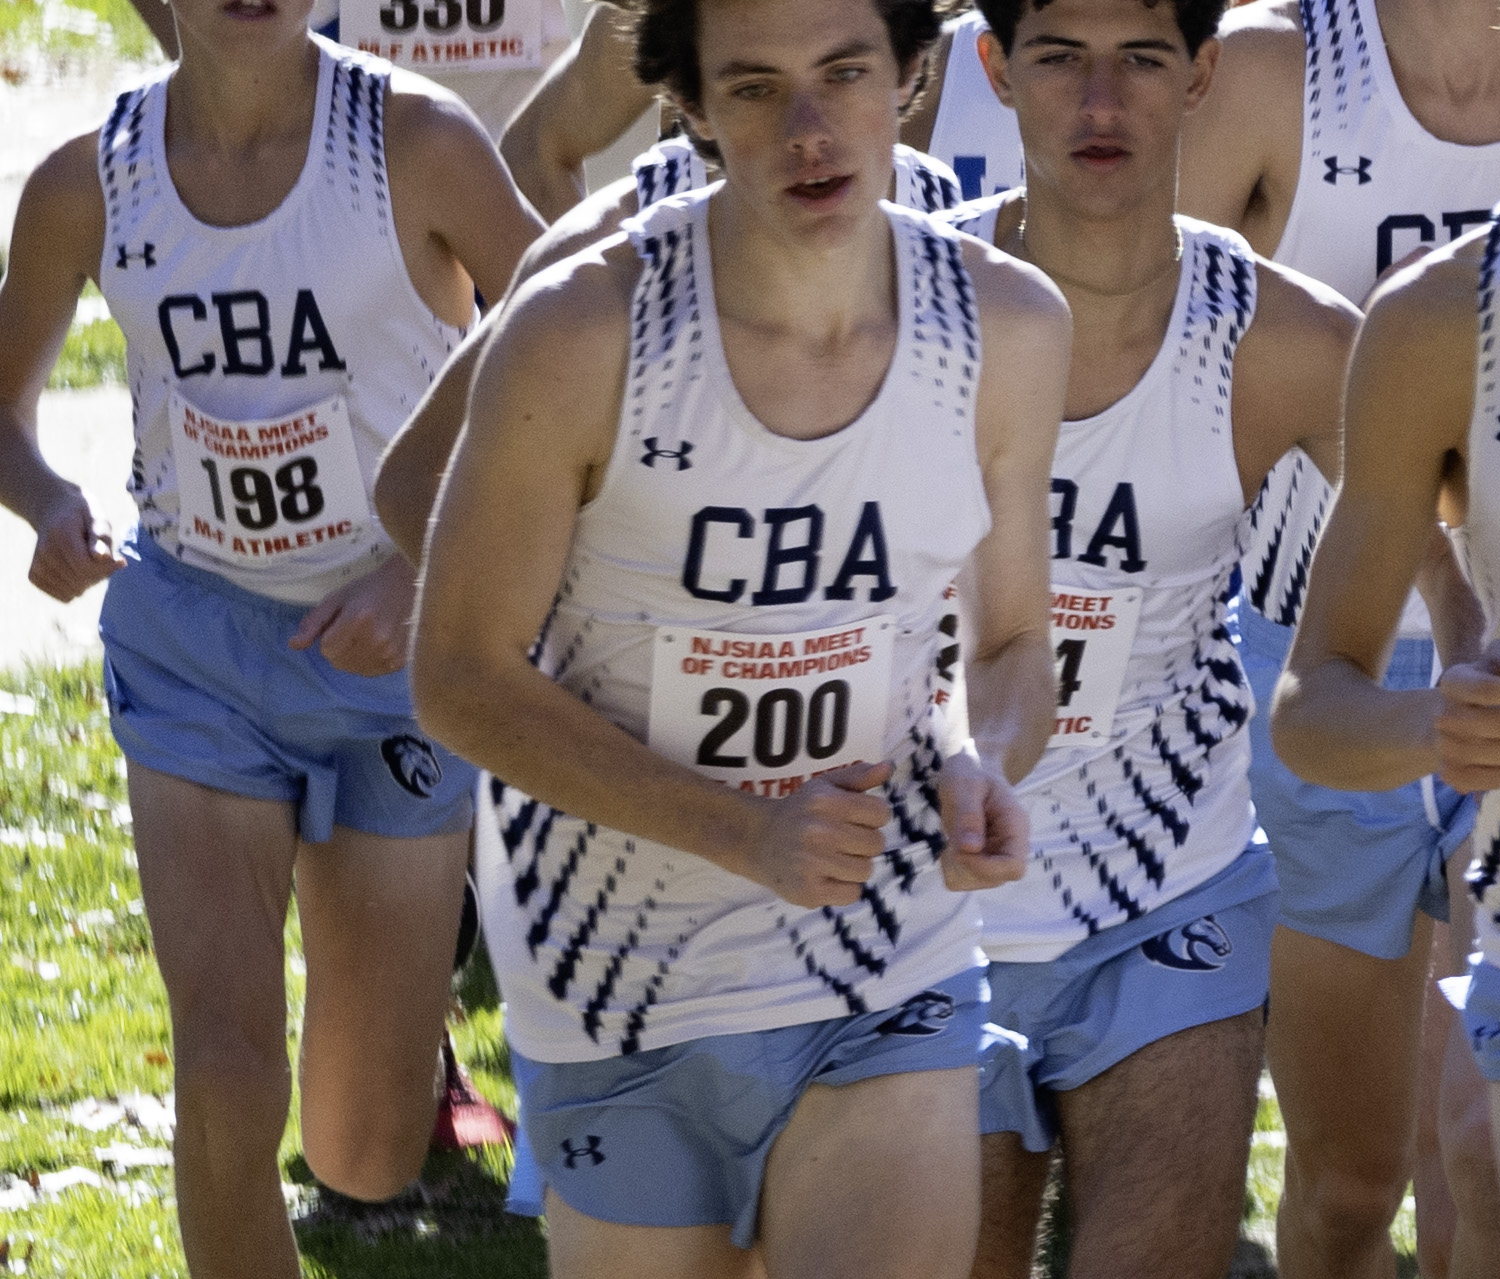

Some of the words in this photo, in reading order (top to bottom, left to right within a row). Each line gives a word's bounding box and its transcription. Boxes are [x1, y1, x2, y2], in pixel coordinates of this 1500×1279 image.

[412, 38, 524, 61] ATHLETIC
[157, 289, 347, 379] CBA
[183, 423, 203, 443] OF
[204, 424, 329, 460] CHAMPIONS
[184, 407, 250, 442] NJSIAA
[257, 410, 317, 440] MEET
[200, 456, 325, 531] 198
[232, 520, 353, 557] ATHLETIC
[681, 501, 898, 607] CBA
[691, 634, 797, 661] NJSIAA
[801, 626, 867, 658] MEET
[681, 657, 714, 676] OF
[721, 646, 872, 679] CHAMPIONS
[695, 678, 851, 769] 200
